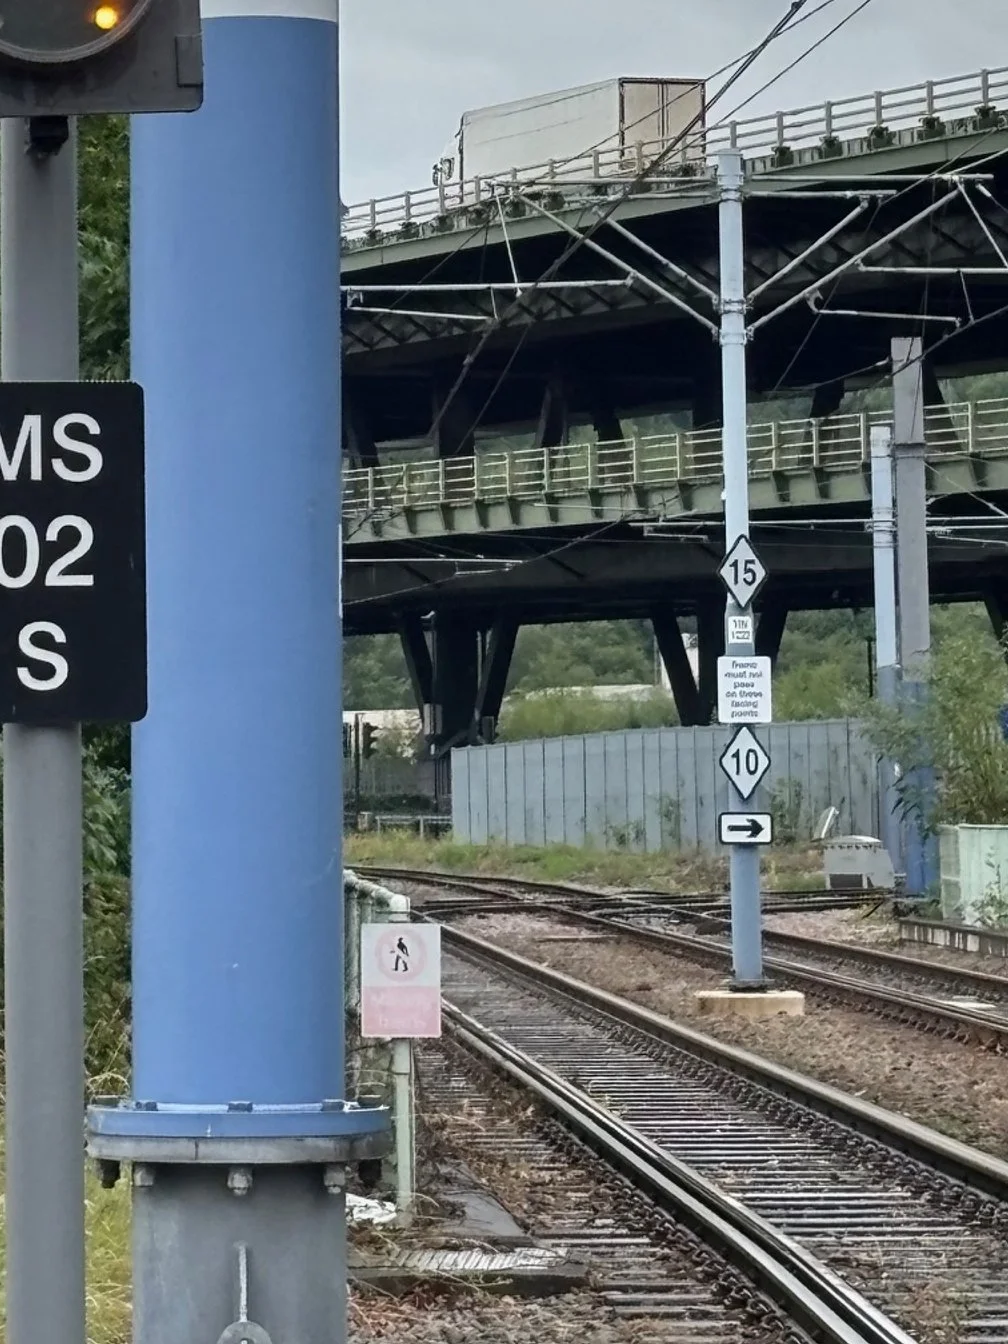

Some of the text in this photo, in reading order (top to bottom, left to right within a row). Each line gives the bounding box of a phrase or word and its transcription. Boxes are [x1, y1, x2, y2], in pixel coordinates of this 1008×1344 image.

[729, 559, 757, 587] 15
[16, 621, 69, 691] S
[731, 748, 759, 775] 10
